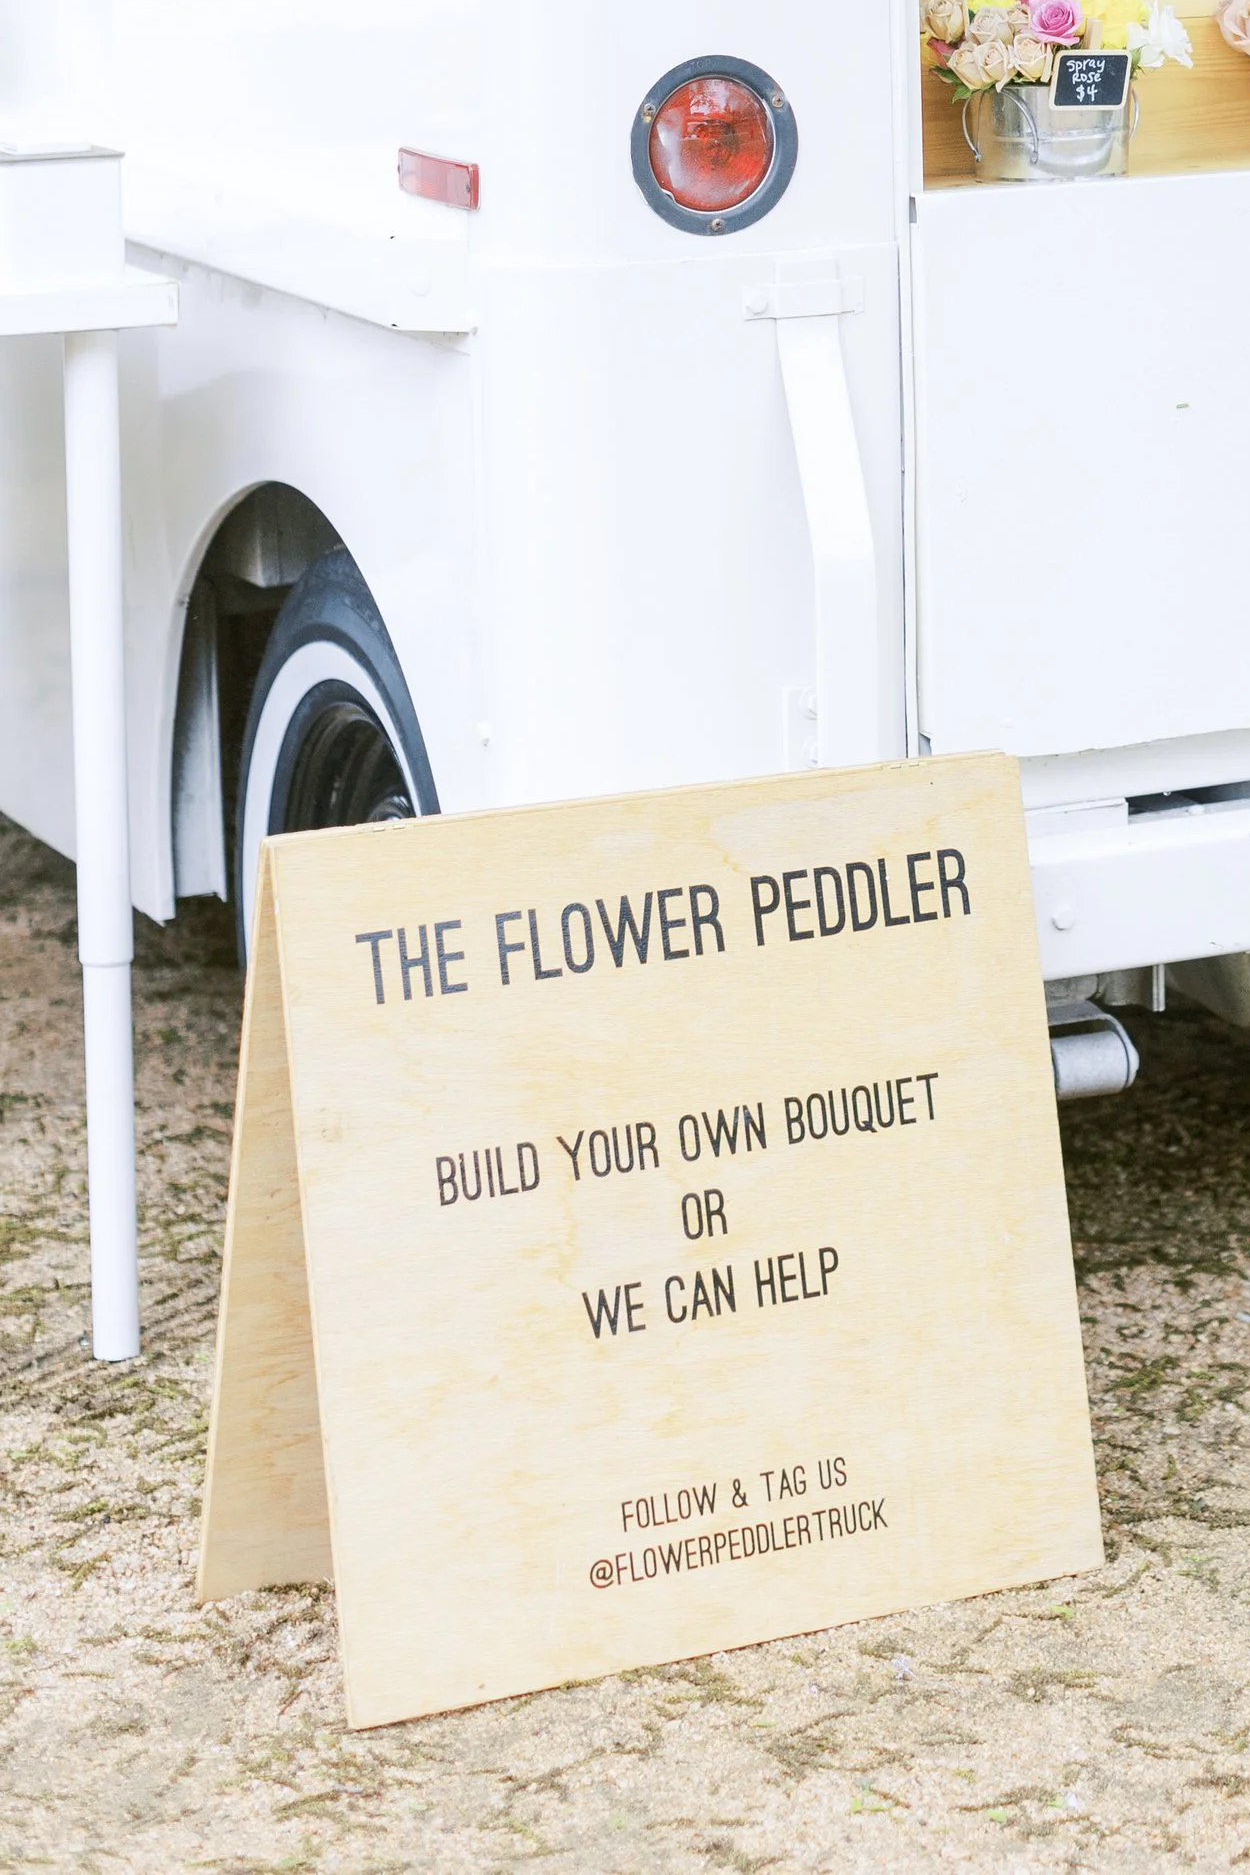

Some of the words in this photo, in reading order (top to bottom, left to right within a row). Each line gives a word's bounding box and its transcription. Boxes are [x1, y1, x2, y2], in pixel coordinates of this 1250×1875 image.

[1075, 84, 1098, 102] $4
[354, 919, 469, 1005] THE
[494, 883, 726, 986] FLOWER
[749, 848, 972, 947] PEDDLER
[435, 1141, 541, 1206] BUILD
[555, 1121, 660, 1181] YOUR
[678, 1101, 768, 1162] OWN
[783, 1072, 939, 1145] BOUQUET
[681, 1188, 728, 1240] OR
[582, 1281, 647, 1339] WE
[664, 1264, 737, 1324] CAN
[753, 1246, 839, 1308] HELP
[621, 1482, 717, 1533] FOLLOW
[731, 1478, 749, 1509] &
[759, 1465, 807, 1502] TAG
[818, 1456, 848, 1490] US
[589, 1497, 888, 1589] @FLOWERPEDDLERTRUCK
